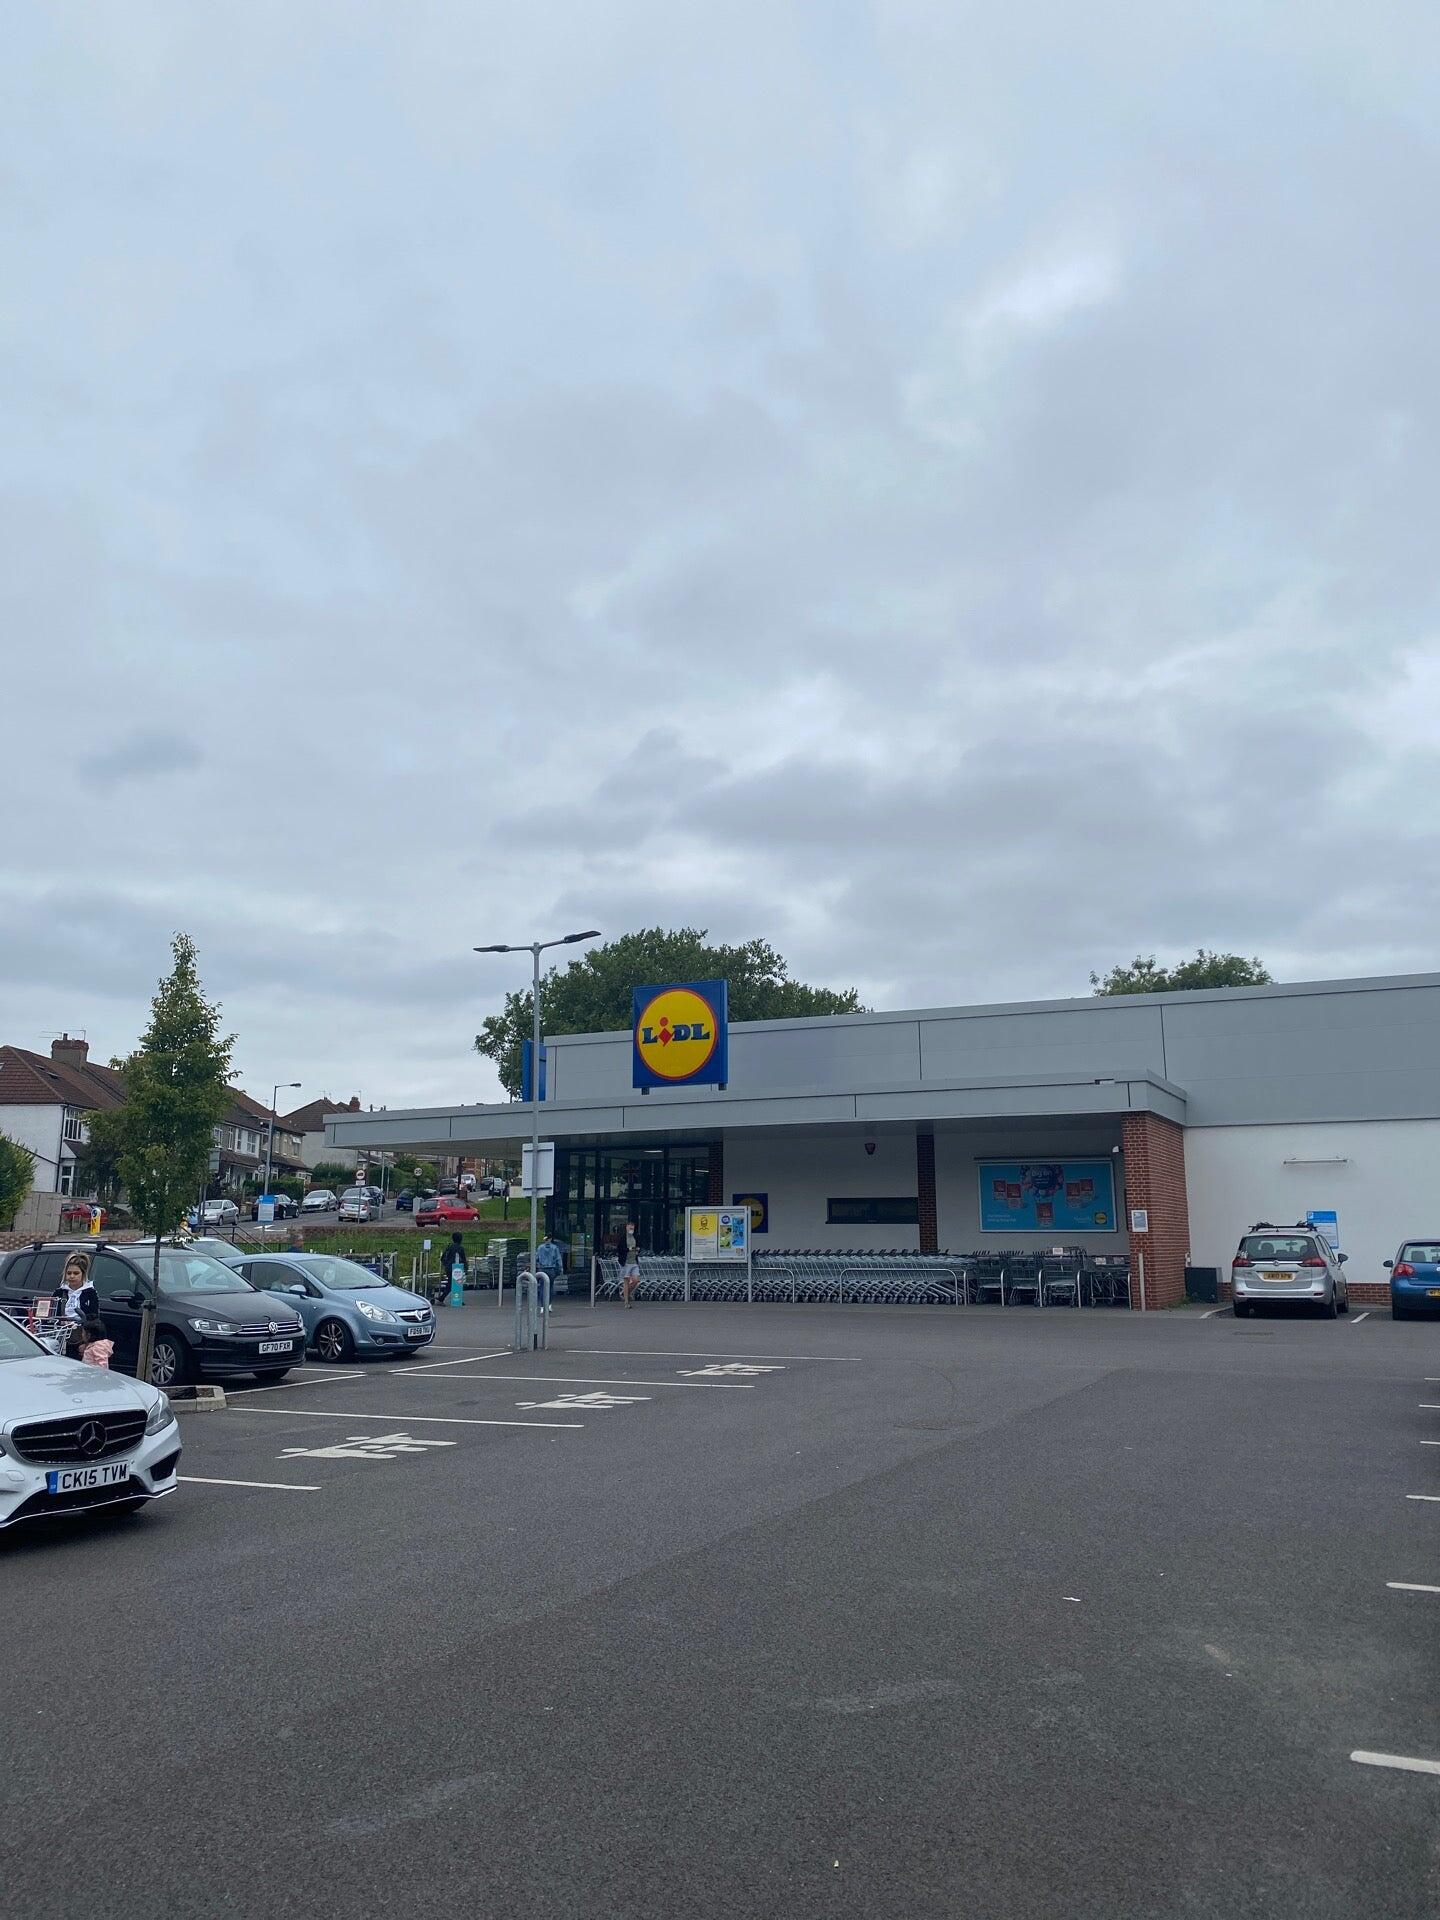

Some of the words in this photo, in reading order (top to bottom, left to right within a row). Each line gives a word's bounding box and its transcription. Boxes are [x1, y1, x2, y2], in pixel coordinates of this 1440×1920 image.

[261, 1343, 279, 1352] GF70
[279, 1341, 291, 1350] FXR
[62, 1469, 98, 1489] CK15
[102, 1463, 127, 1483] TVM
